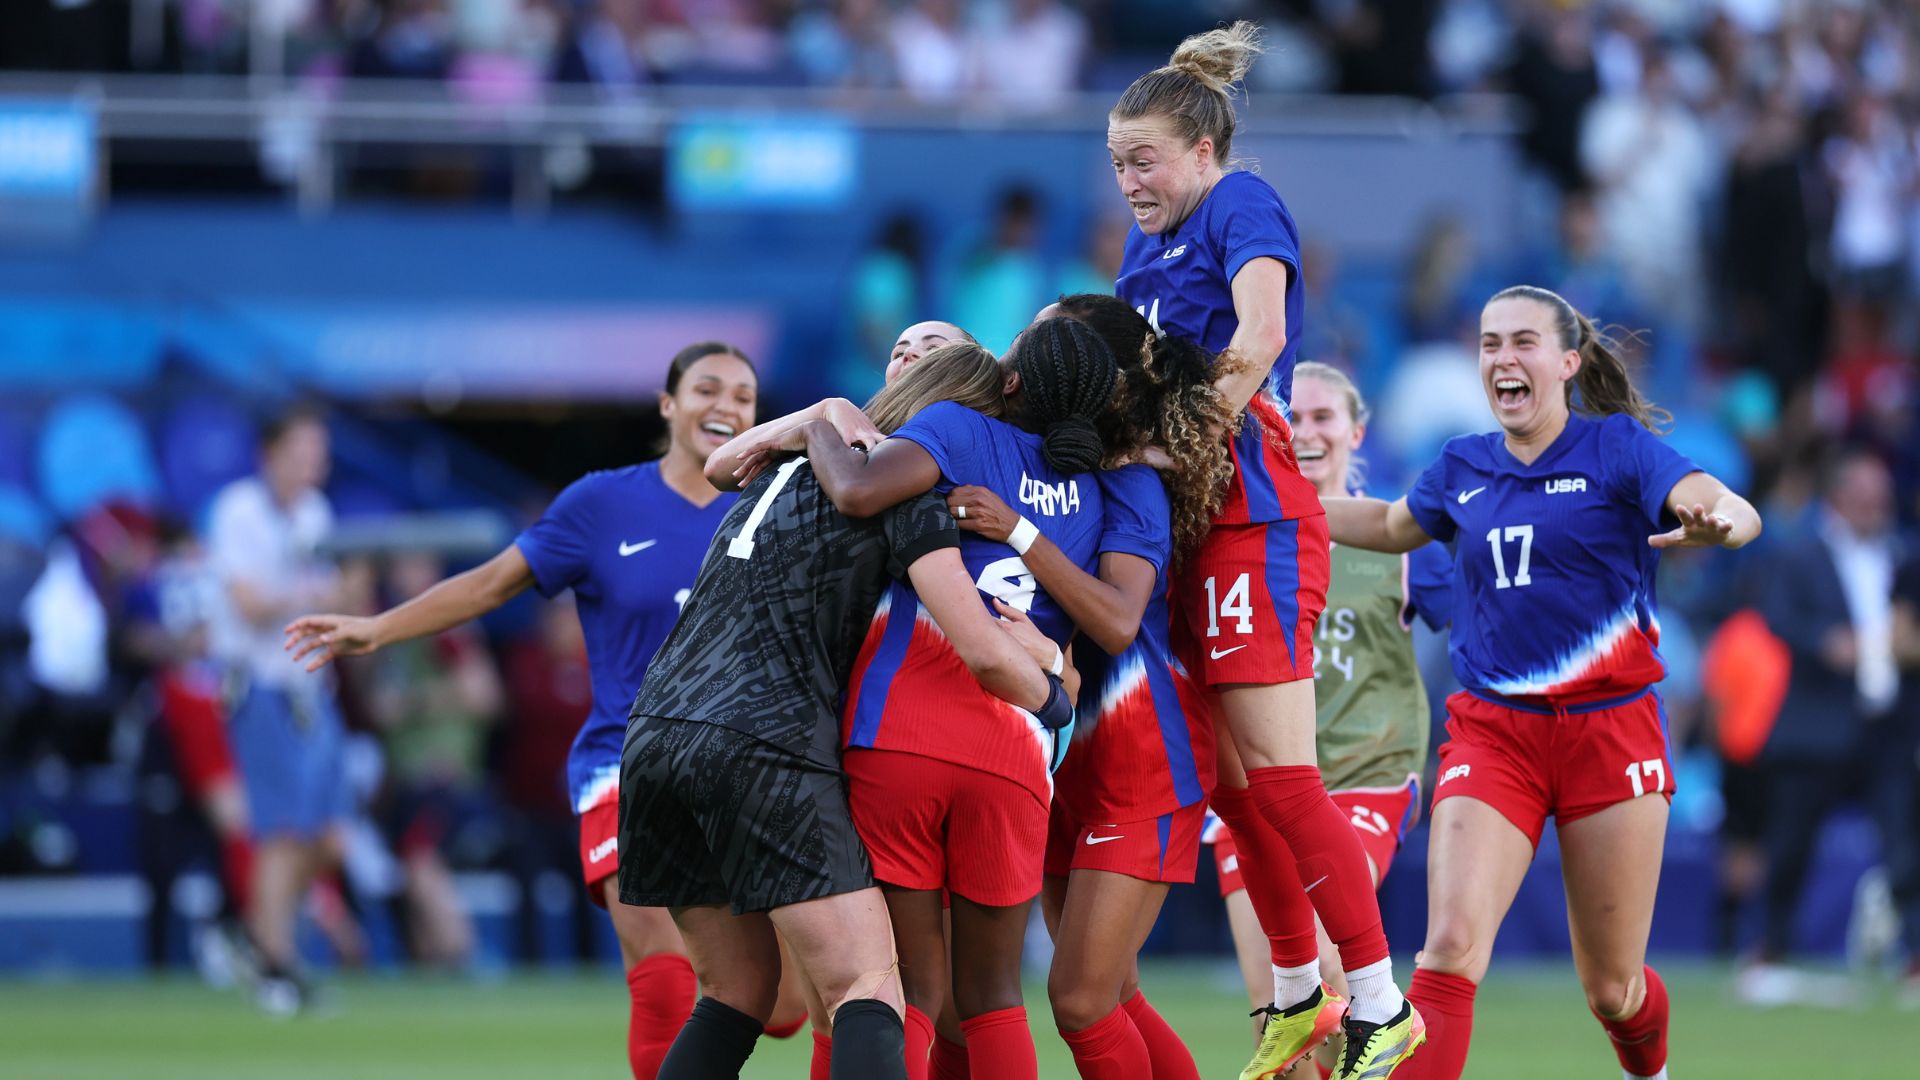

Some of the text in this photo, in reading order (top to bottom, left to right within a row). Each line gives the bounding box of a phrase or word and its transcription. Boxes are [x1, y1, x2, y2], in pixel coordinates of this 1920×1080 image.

[727, 456, 809, 559] 1
[1545, 478, 1586, 494] USA
[1486, 524, 1533, 589] 17
[1204, 573, 1253, 637] 14
[1439, 764, 1471, 786] USA
[1625, 758, 1665, 798] 17
